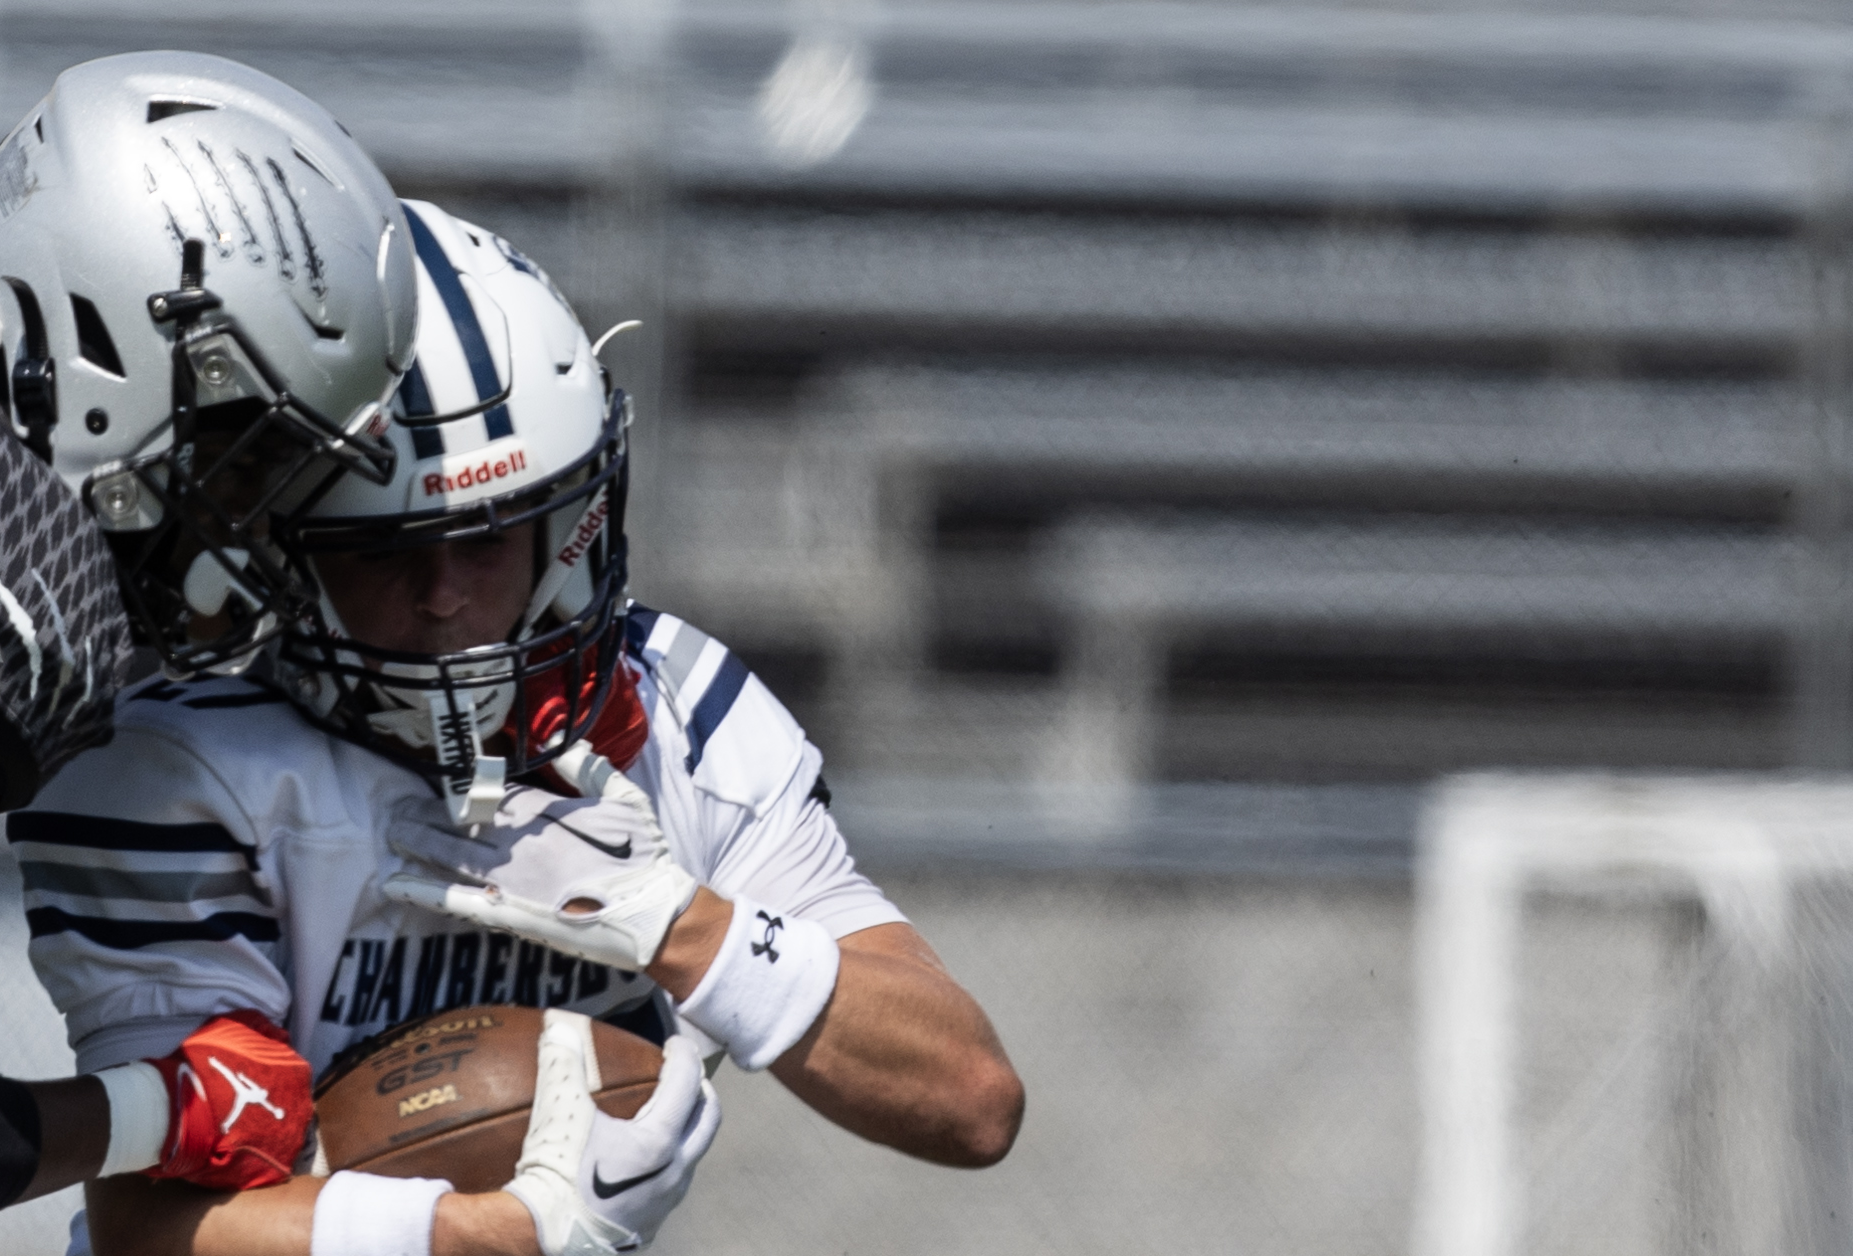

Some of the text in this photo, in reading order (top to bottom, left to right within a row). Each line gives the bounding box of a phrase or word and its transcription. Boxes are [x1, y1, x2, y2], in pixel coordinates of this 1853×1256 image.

[423, 449, 527, 496] Riddell
[557, 490, 609, 568] Ridde
[376, 1048, 475, 1096] GST
[398, 1083, 458, 1118] NCAA
